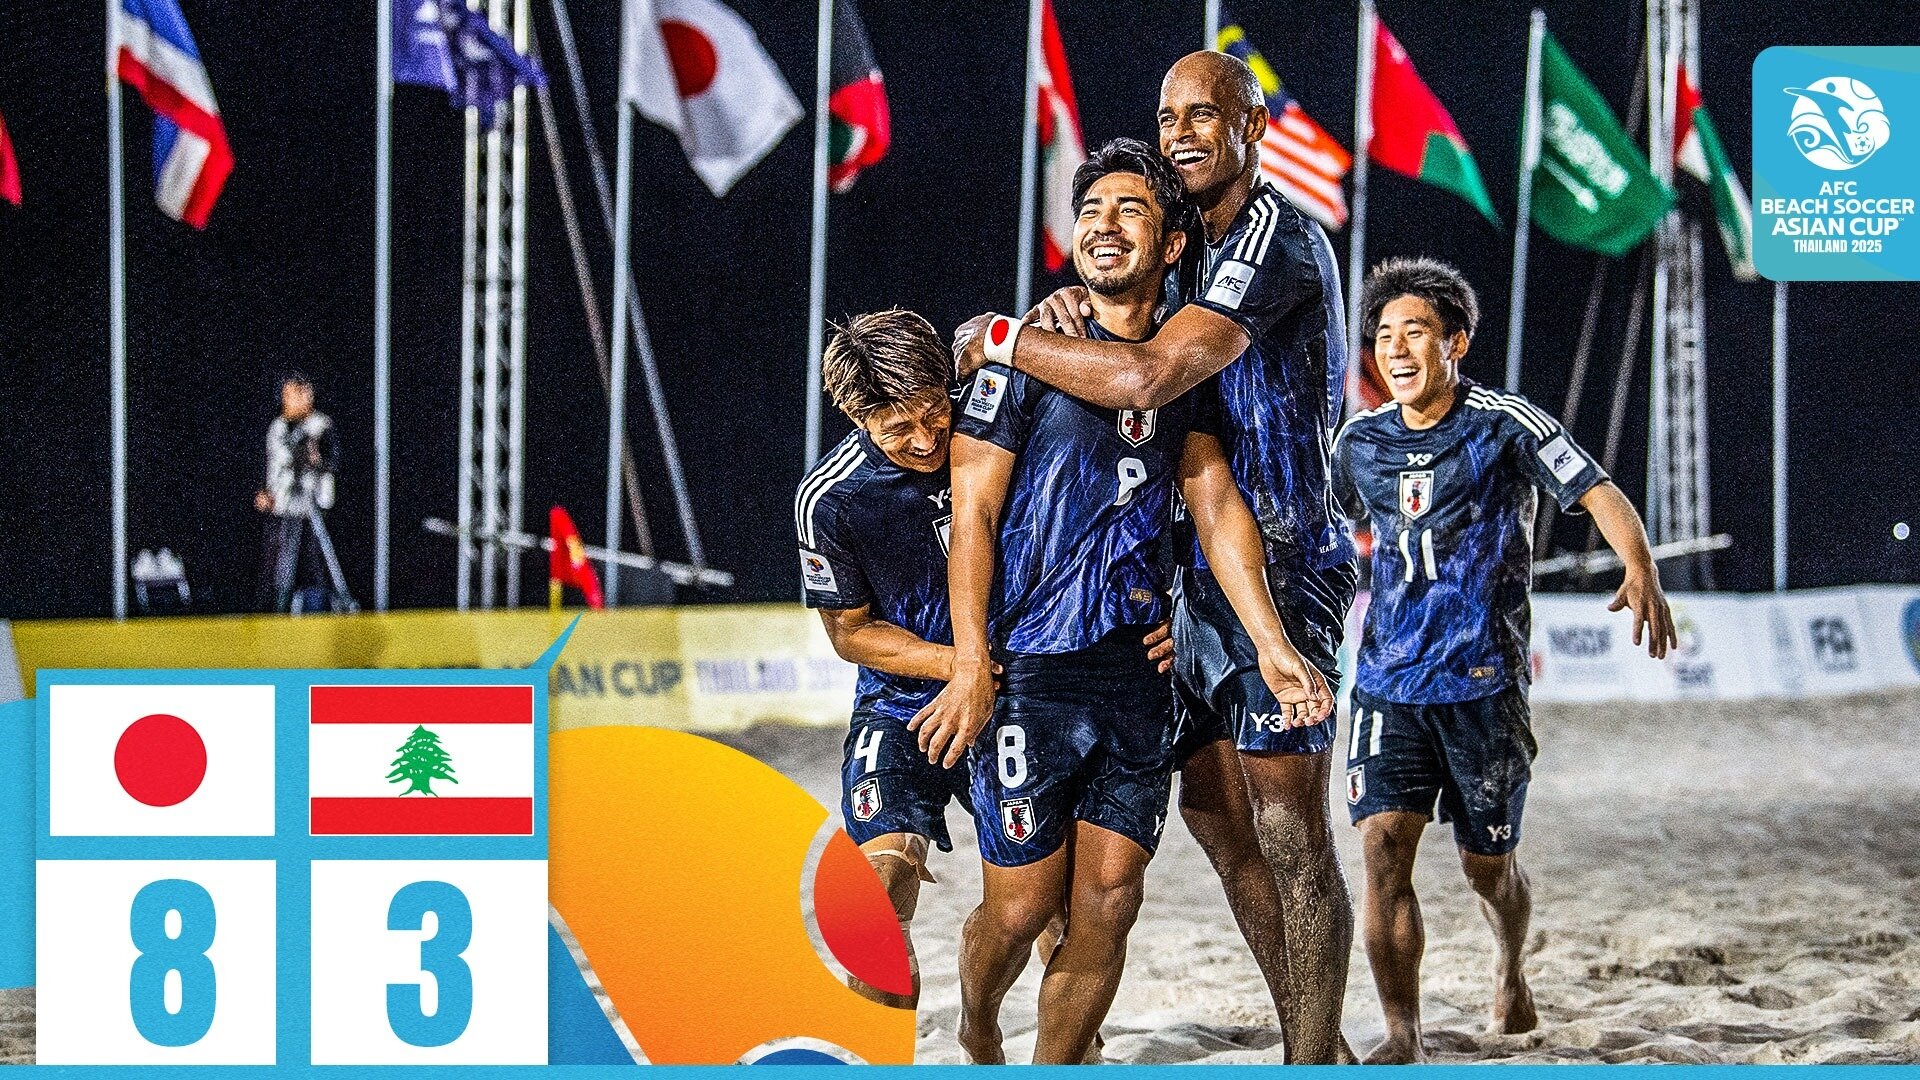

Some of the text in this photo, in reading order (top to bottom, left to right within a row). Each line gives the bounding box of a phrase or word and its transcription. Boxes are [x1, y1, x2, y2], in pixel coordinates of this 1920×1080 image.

[1217, 275, 1247, 291] AFC
[1553, 450, 1572, 470] AFC
[1399, 528, 1438, 583] 11
[611, 659, 683, 698] CUP
[1249, 712, 1287, 733] Y-3
[1350, 707, 1383, 760] 11
[854, 725, 884, 774] 4
[997, 725, 1028, 789] 8
[1486, 824, 1511, 841] Y-3
